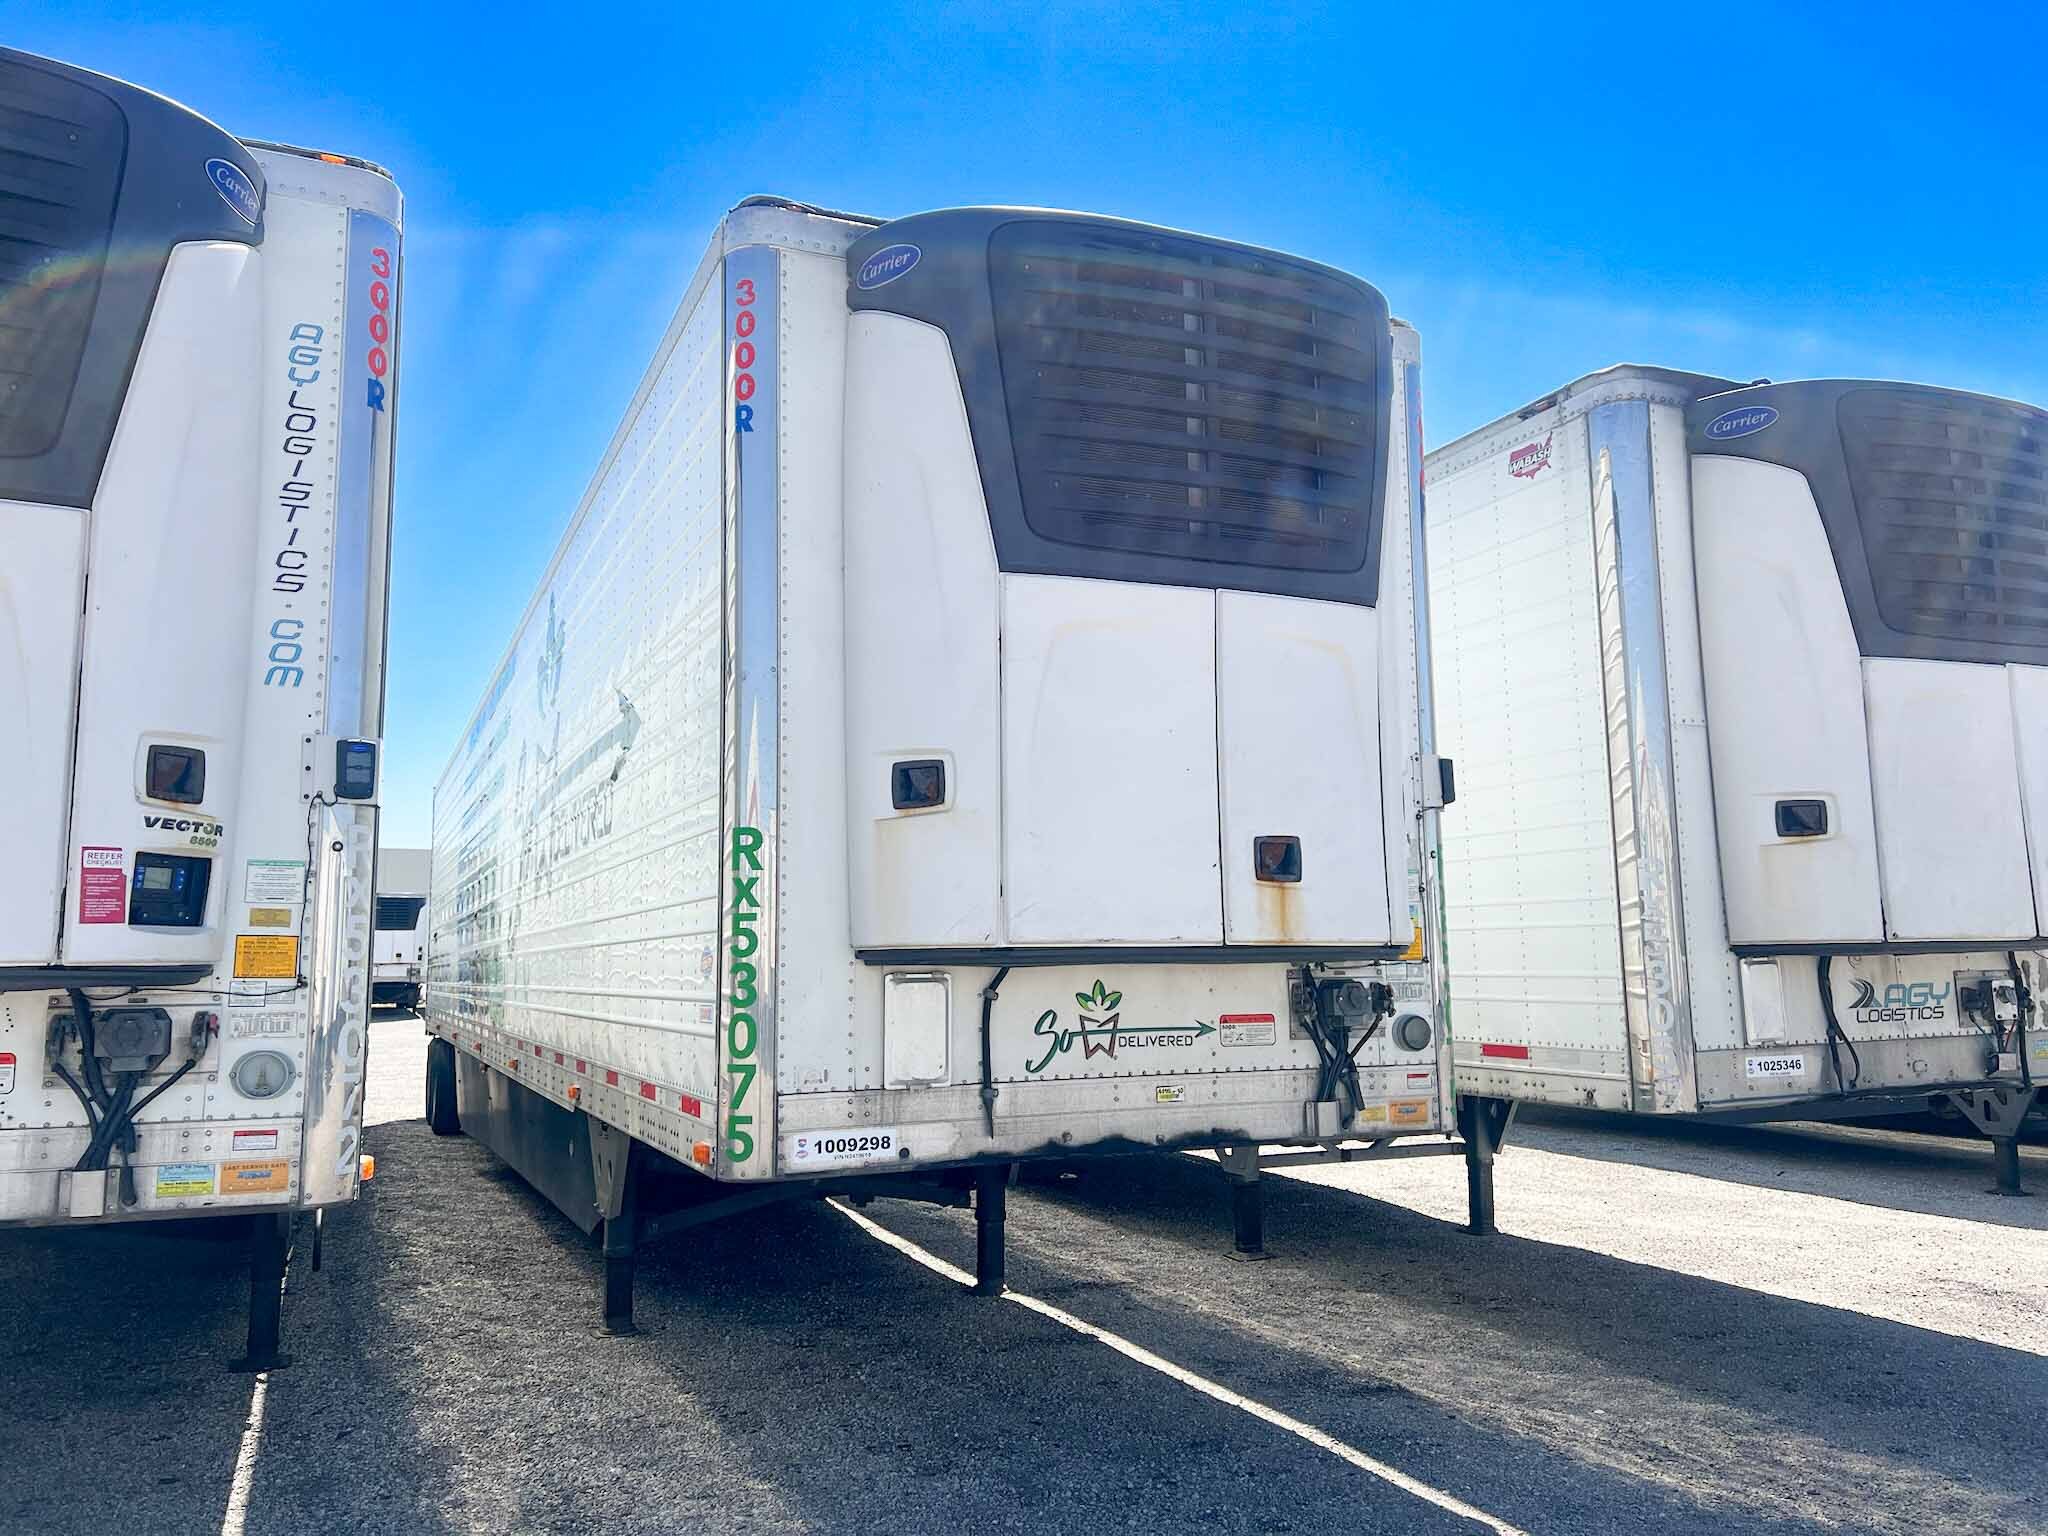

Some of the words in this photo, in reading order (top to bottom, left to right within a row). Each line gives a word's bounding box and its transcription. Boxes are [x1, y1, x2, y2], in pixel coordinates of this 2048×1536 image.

[215, 166, 259, 210] Carrier
[862, 252, 911, 282] Carrier
[366, 247, 391, 413] 3000R
[734, 278, 757, 433] 3000R
[1711, 409, 1770, 435] Carrier
[1508, 446, 1552, 474] WABASH
[143, 815, 224, 837] VECTOR
[87, 851, 123, 860] REEFER
[1883, 981, 1951, 1008] AGY
[1856, 1005, 1945, 1023] LOGISTICS
[1025, 1009, 1075, 1073] So
[1118, 1034, 1194, 1048] DELIVERED
[1756, 1059, 1802, 1072] 1025346
[814, 1135, 891, 1155] 1009298
